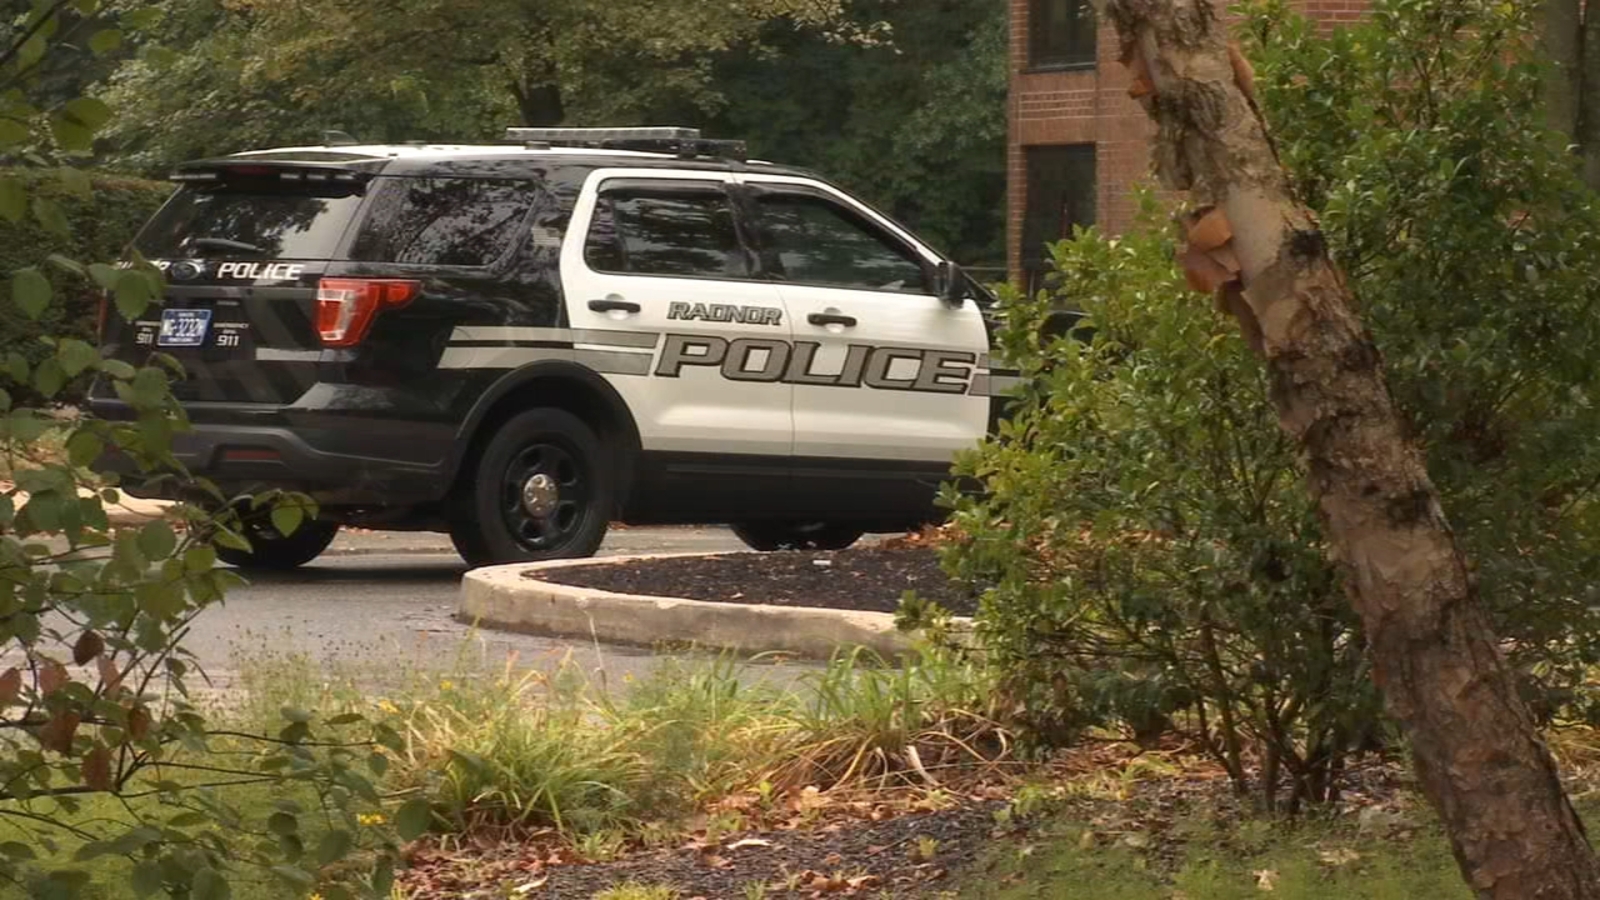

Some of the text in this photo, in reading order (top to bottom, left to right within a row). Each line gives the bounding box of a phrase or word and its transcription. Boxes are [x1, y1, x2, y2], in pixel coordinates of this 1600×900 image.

[217, 261, 305, 281] POLICE
[667, 301, 783, 326] RADNOR
[135, 333, 153, 344] 911
[216, 335, 239, 346] 911
[654, 333, 976, 394] POLICE
